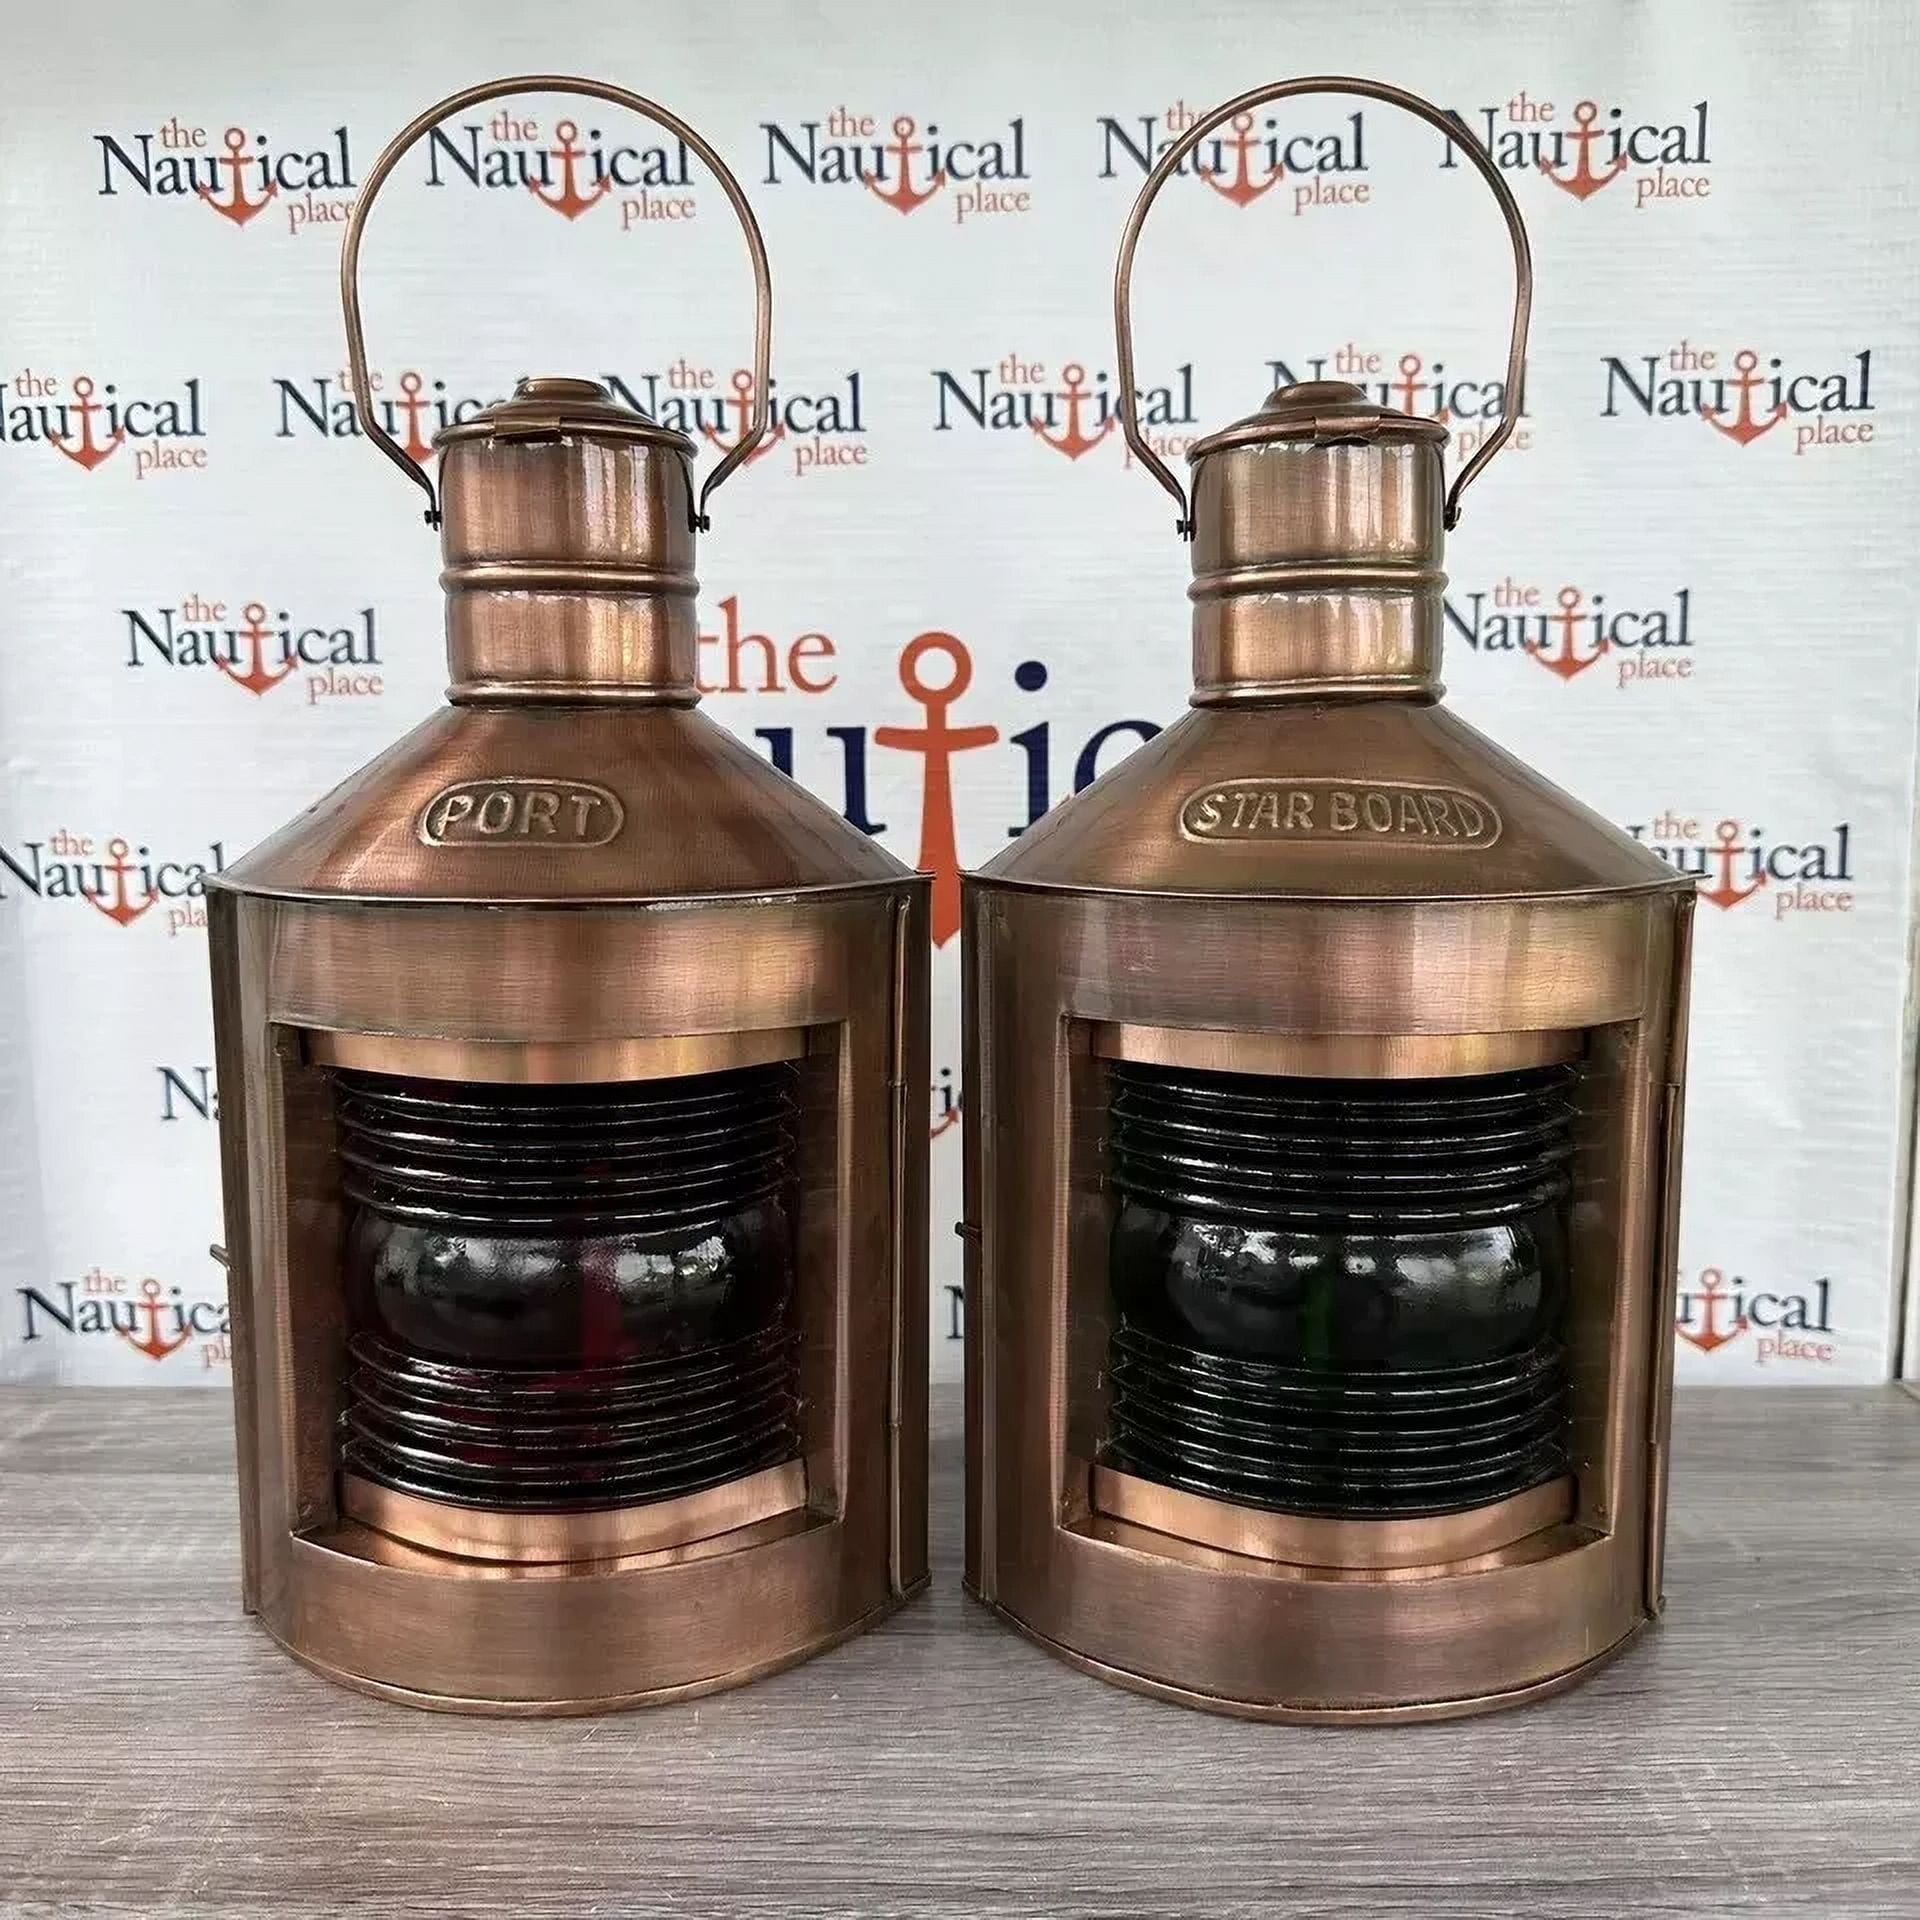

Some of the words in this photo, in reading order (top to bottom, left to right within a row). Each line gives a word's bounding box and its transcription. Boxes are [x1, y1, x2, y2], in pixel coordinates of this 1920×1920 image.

[828, 105, 875, 137] the
[1165, 98, 1209, 131] th
[1507, 91, 1555, 122] the
[160, 117, 206, 148] the
[489, 109, 539, 142] the
[94, 126, 357, 226] Nautical
[426, 121, 695, 221] Nautical
[760, 115, 1031, 215] Nautical
[956, 182, 1031, 225] place
[1294, 175, 1370, 216] place
[1635, 167, 1710, 208] place
[621, 190, 696, 231] place
[1000, 353, 1044, 384] the
[1336, 343, 1381, 373] the
[1669, 339, 1716, 371] the
[15, 368, 59, 397] the
[669, 359, 715, 389] the
[1600, 350, 1875, 447] Nautical
[1795, 415, 1873, 455] place
[135, 440, 208, 480] place
[795, 437, 866, 476] place
[183, 593, 226, 622] the
[1494, 577, 1540, 608] the
[122, 602, 382, 699] Nautical
[1617, 650, 1693, 688] place
[307, 668, 384, 705] place
[434, 791, 600, 837] PORT
[1653, 811, 1697, 839] the
[51, 829, 93, 856] the
[1775, 884, 1855, 921] place
[1756, 1330, 1836, 1364] place
